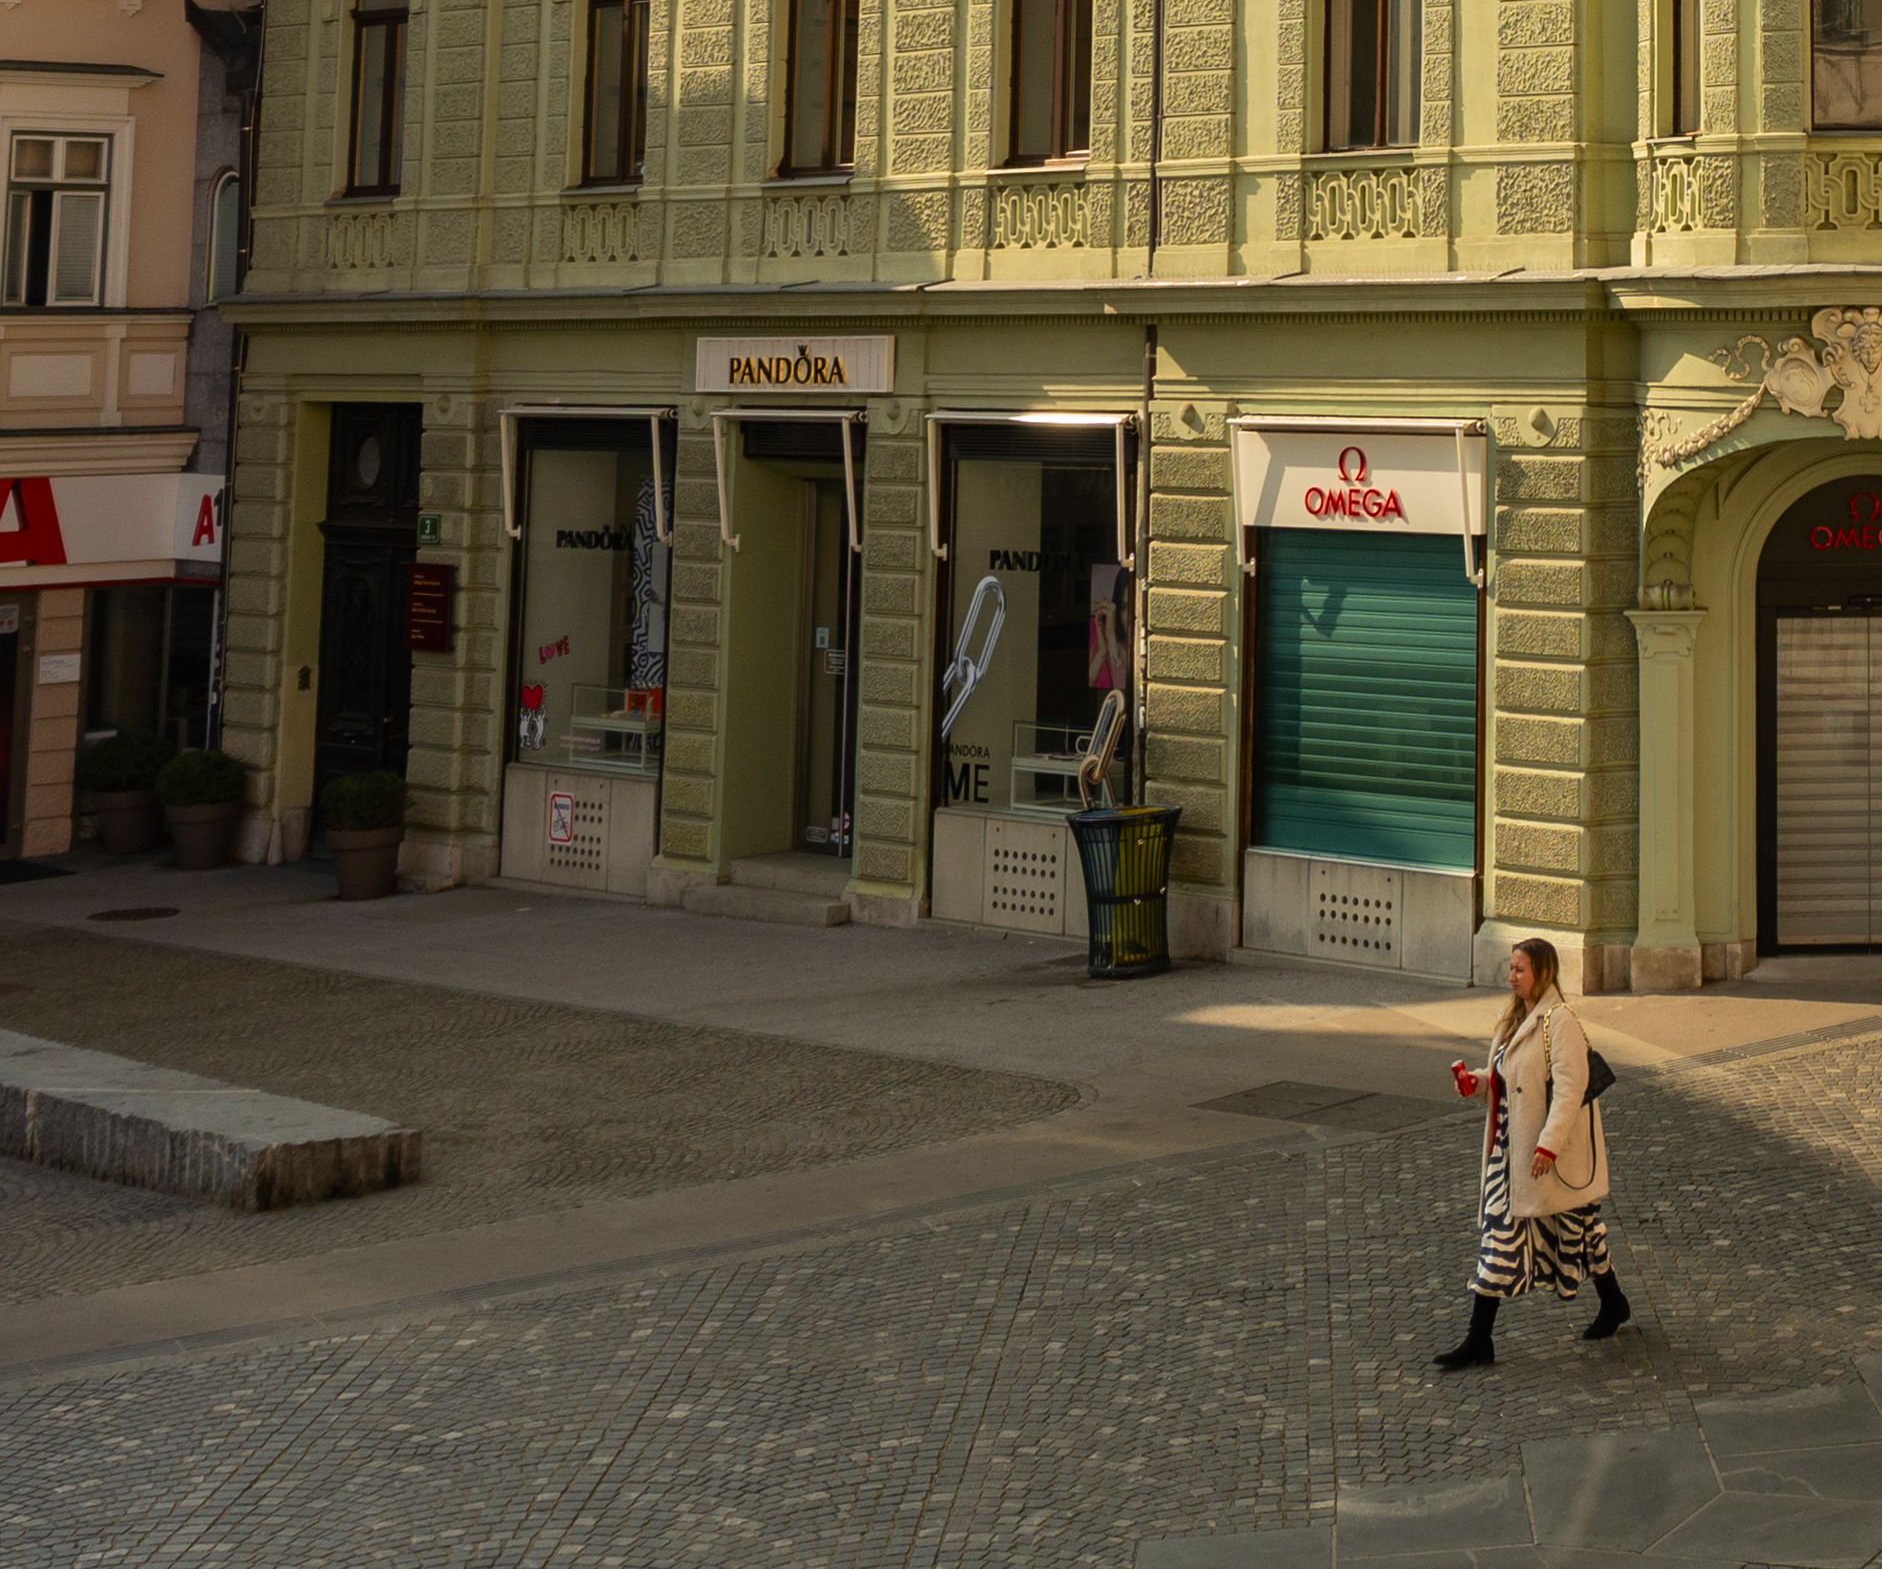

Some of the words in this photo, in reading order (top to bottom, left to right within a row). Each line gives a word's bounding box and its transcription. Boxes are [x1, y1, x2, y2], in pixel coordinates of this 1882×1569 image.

[729, 346, 845, 384] PANDORA
[1304, 486, 1403, 519] OMEGA
[538, 636, 569, 665] LOVE
[946, 743, 990, 759] ANDORA
[944, 761, 990, 803] ME
